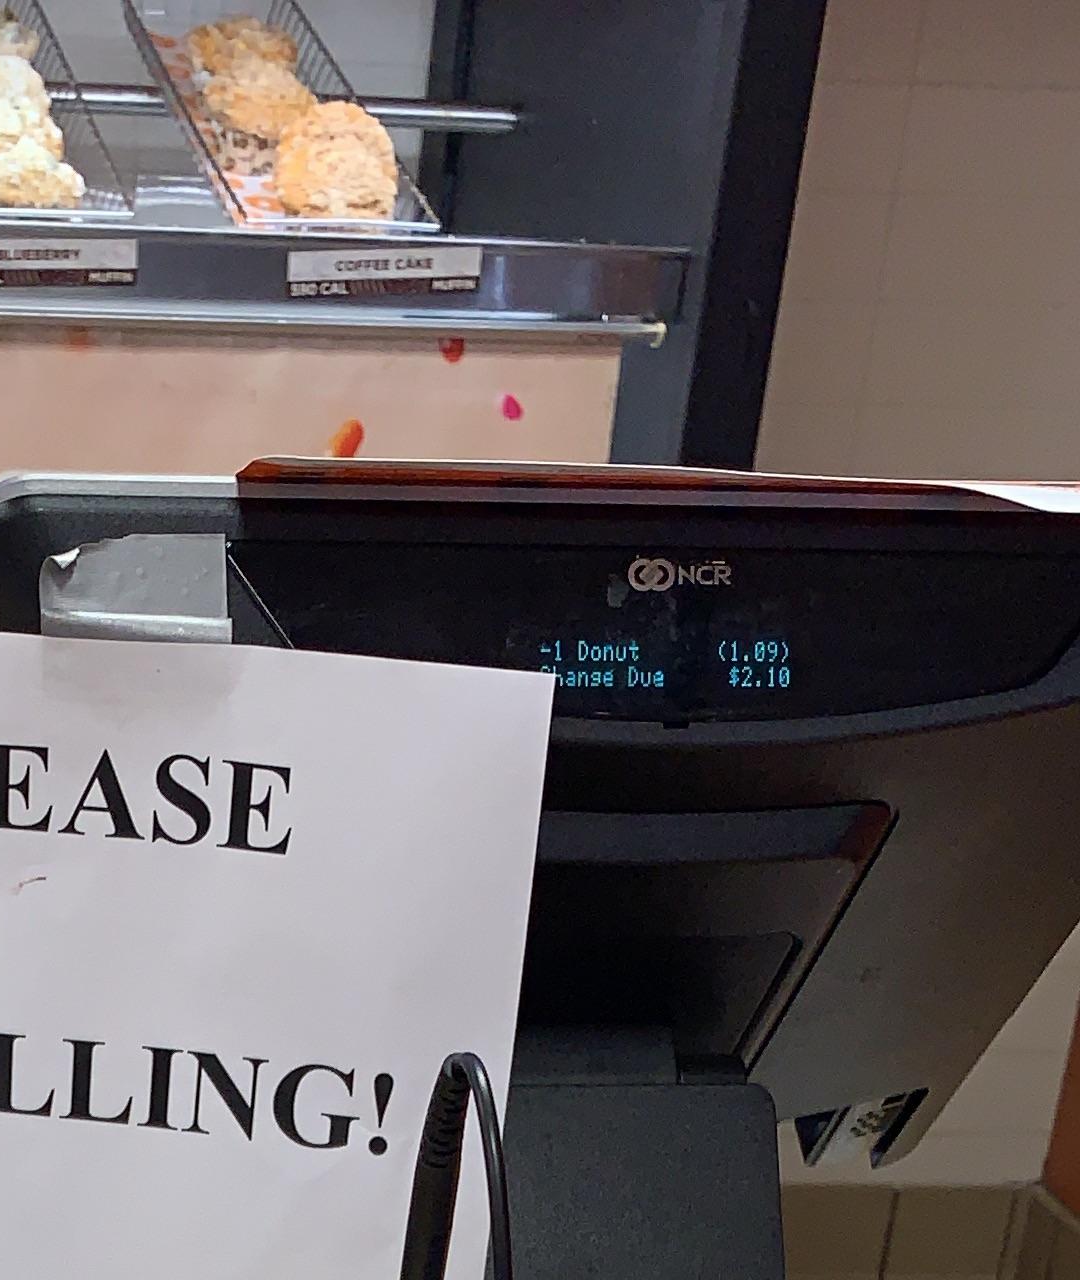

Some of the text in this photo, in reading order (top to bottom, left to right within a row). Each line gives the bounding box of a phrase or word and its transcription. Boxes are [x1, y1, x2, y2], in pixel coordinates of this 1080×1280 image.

[334, 258, 433, 271] COFFEE CAKE
[320, 282, 349, 294] CAL
[677, 564, 732, 585] NCR
[540, 640, 789, 662] -1 Donut (1.09)
[627, 666, 664, 688] Due
[728, 667, 790, 688] $2.10
